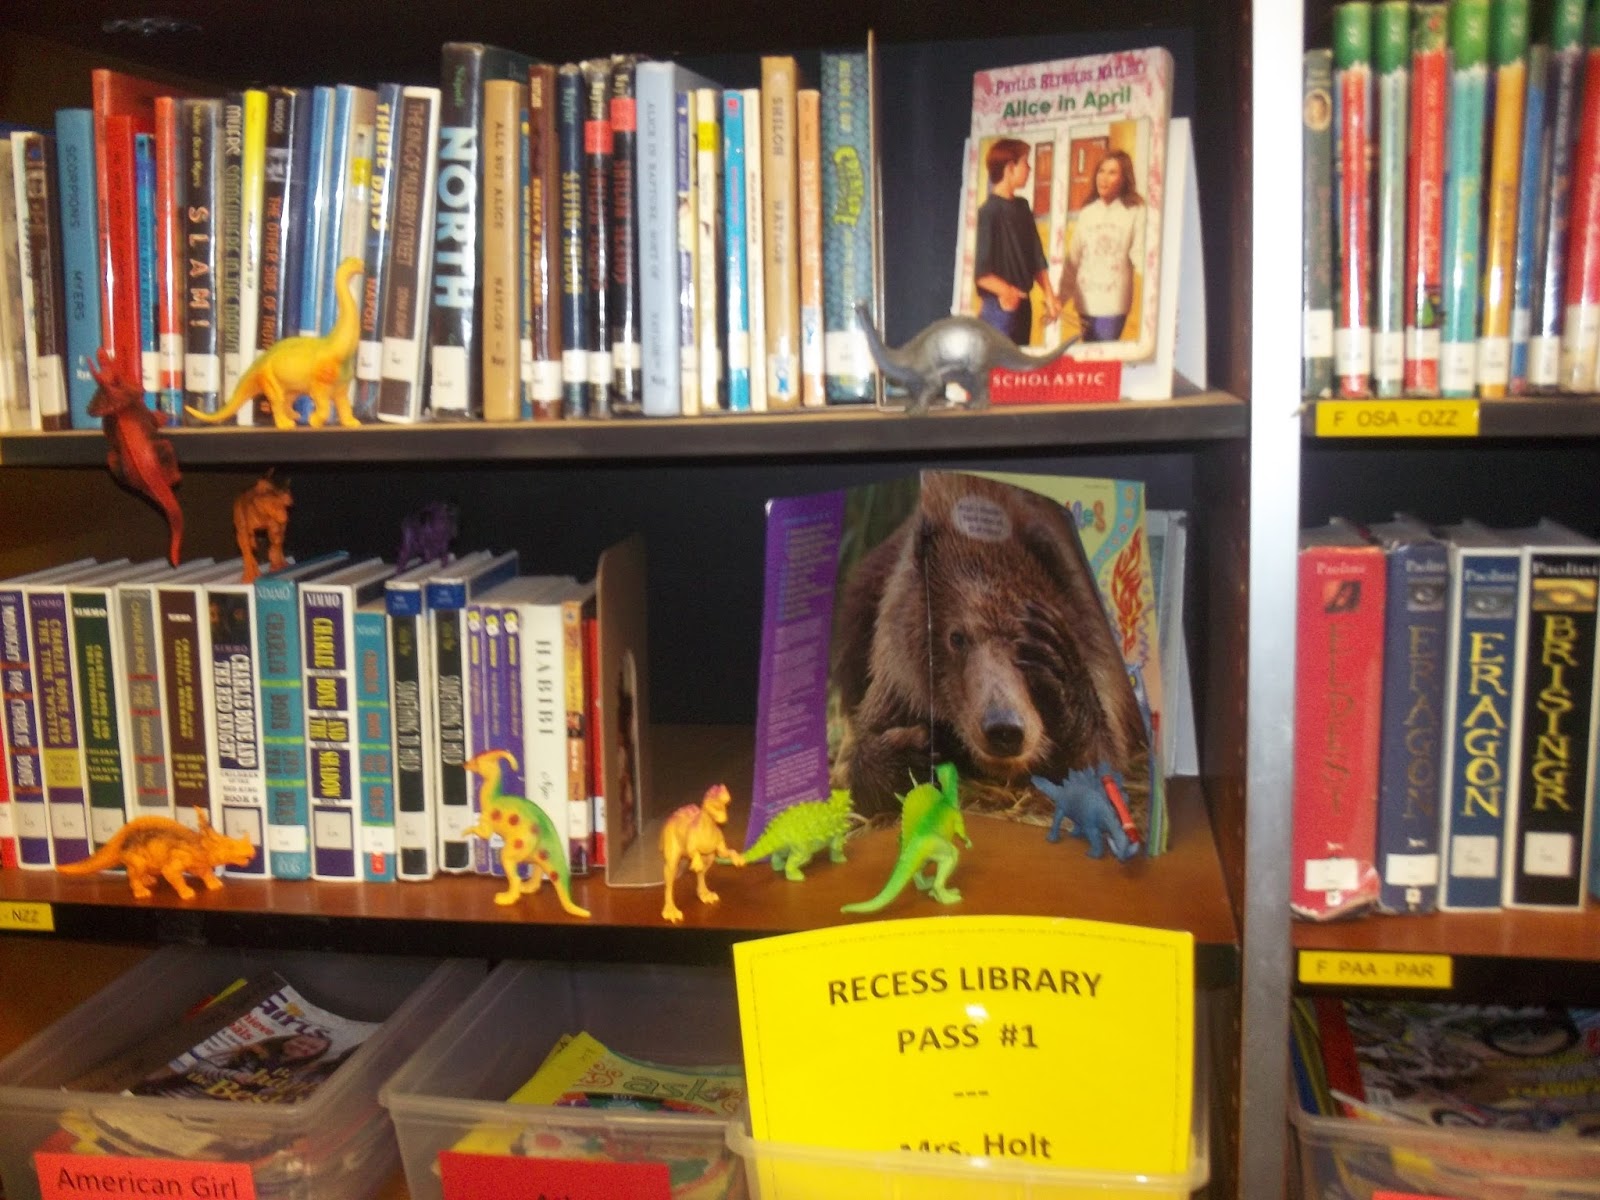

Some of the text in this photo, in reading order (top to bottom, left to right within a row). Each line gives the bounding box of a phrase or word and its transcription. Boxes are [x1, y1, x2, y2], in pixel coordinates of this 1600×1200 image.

[1003, 101, 1052, 119] Alice
[1058, 94, 1075, 112] in
[1083, 86, 1132, 111] April
[369, 103, 393, 231] THREE DAYS
[65, 145, 80, 228] SCORPIONS
[435, 127, 478, 309] NORTH
[71, 270, 85, 321] MYERS
[991, 371, 1106, 389] SCHOLASTIC
[1333, 411, 1345, 427] F
[1357, 410, 1397, 427] OSA
[1418, 410, 1458, 427] OZZ
[1532, 562, 1599, 576] Paolini
[306, 593, 341, 607] NIMMO
[37, 617, 50, 644] THE
[50, 618, 67, 673] CHARLIE
[313, 617, 335, 668] CHARLIE
[213, 660, 232, 687] THE
[230, 654, 253, 710] CHARLIE
[535, 639, 554, 735] HABIBI
[54, 678, 70, 713] BONE
[215, 686, 234, 714] RED
[316, 678, 338, 708] BONE
[233, 709, 255, 743] BONE
[1403, 624, 1437, 820] ERAGON
[1461, 631, 1508, 818] ERAGON
[1531, 613, 1578, 812] BRISINGR
[319, 750, 342, 798] SHADOW
[1315, 960, 1327, 975] F
[1339, 961, 1377, 976] PAA
[1395, 962, 1435, 977] PAR
[828, 966, 1102, 1006] RECESS LIBRARY
[897, 1023, 1039, 1054] PASS #1
[983, 1132, 1051, 1159] Holt
[57, 1166, 239, 1200] American Girl
